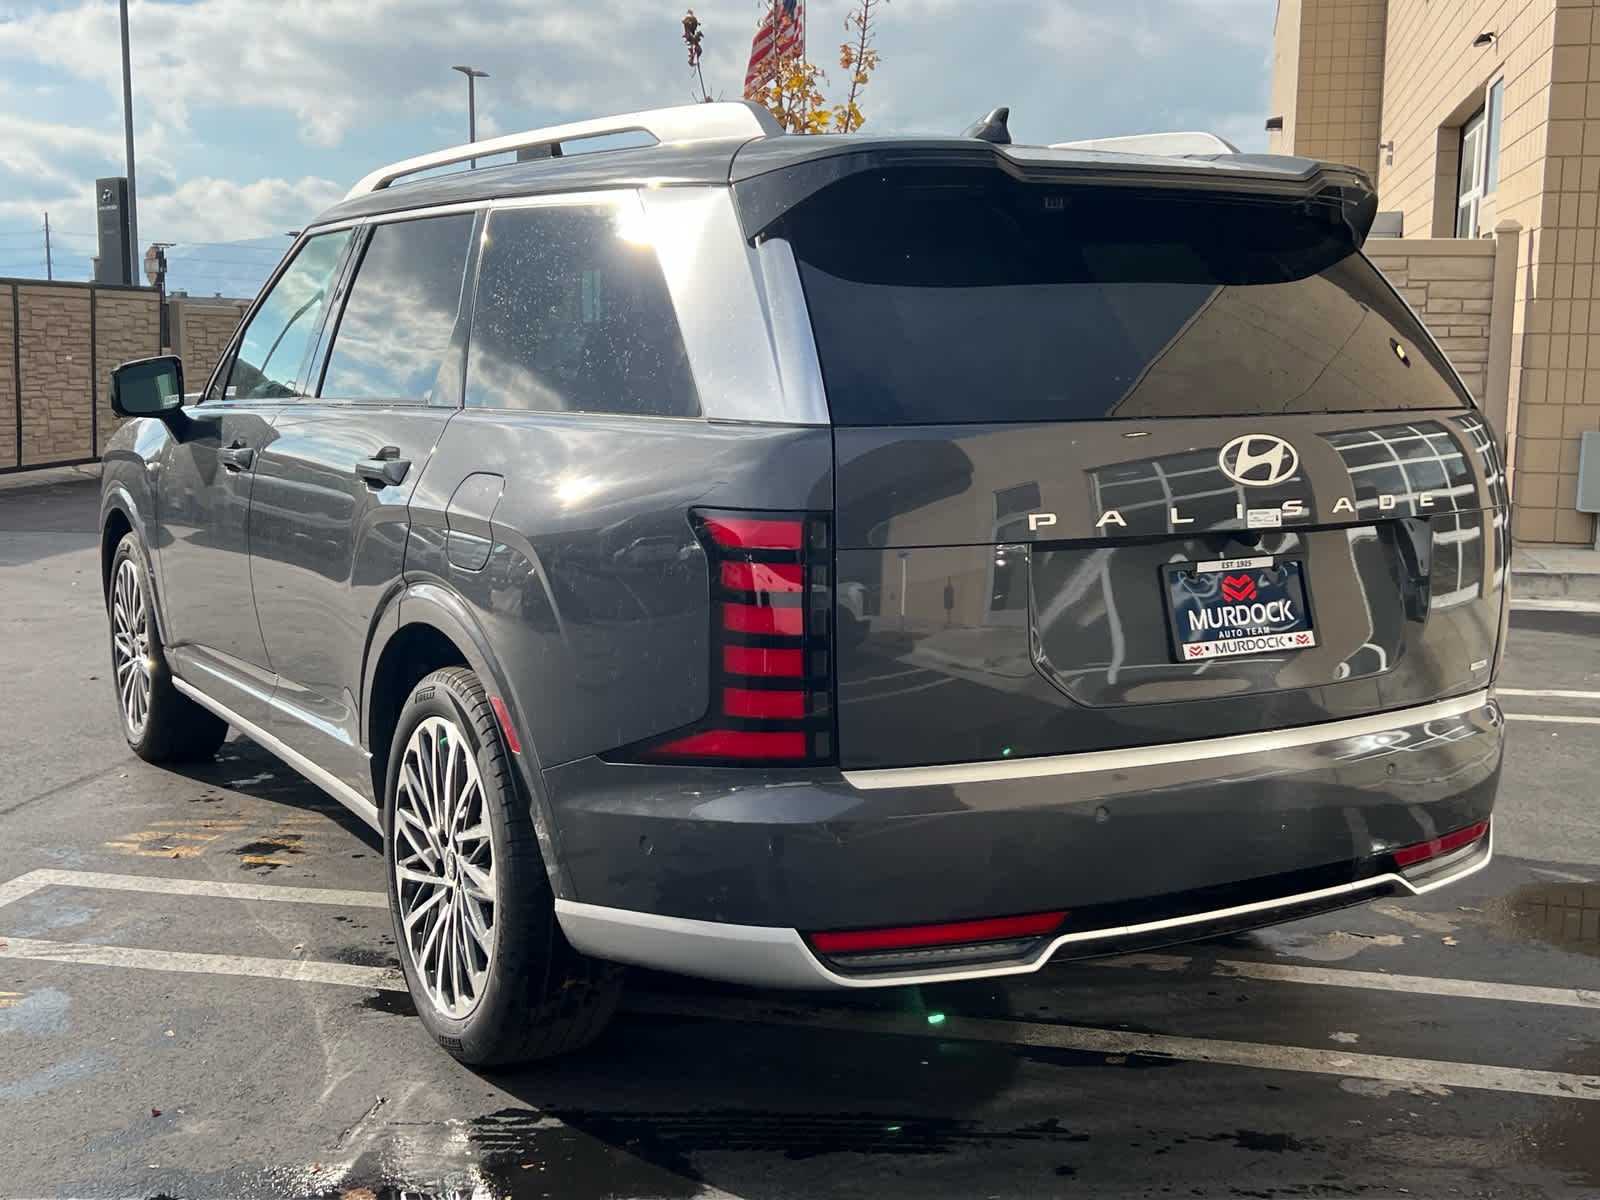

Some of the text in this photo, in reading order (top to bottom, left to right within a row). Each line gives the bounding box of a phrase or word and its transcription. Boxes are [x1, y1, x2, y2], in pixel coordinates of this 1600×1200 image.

[1028, 491, 1435, 532] PALISADE
[1188, 600, 1294, 631] MURDOCK
[1215, 635, 1286, 655] MURDOCK
[1218, 626, 1270, 639] AUTO TEAM
